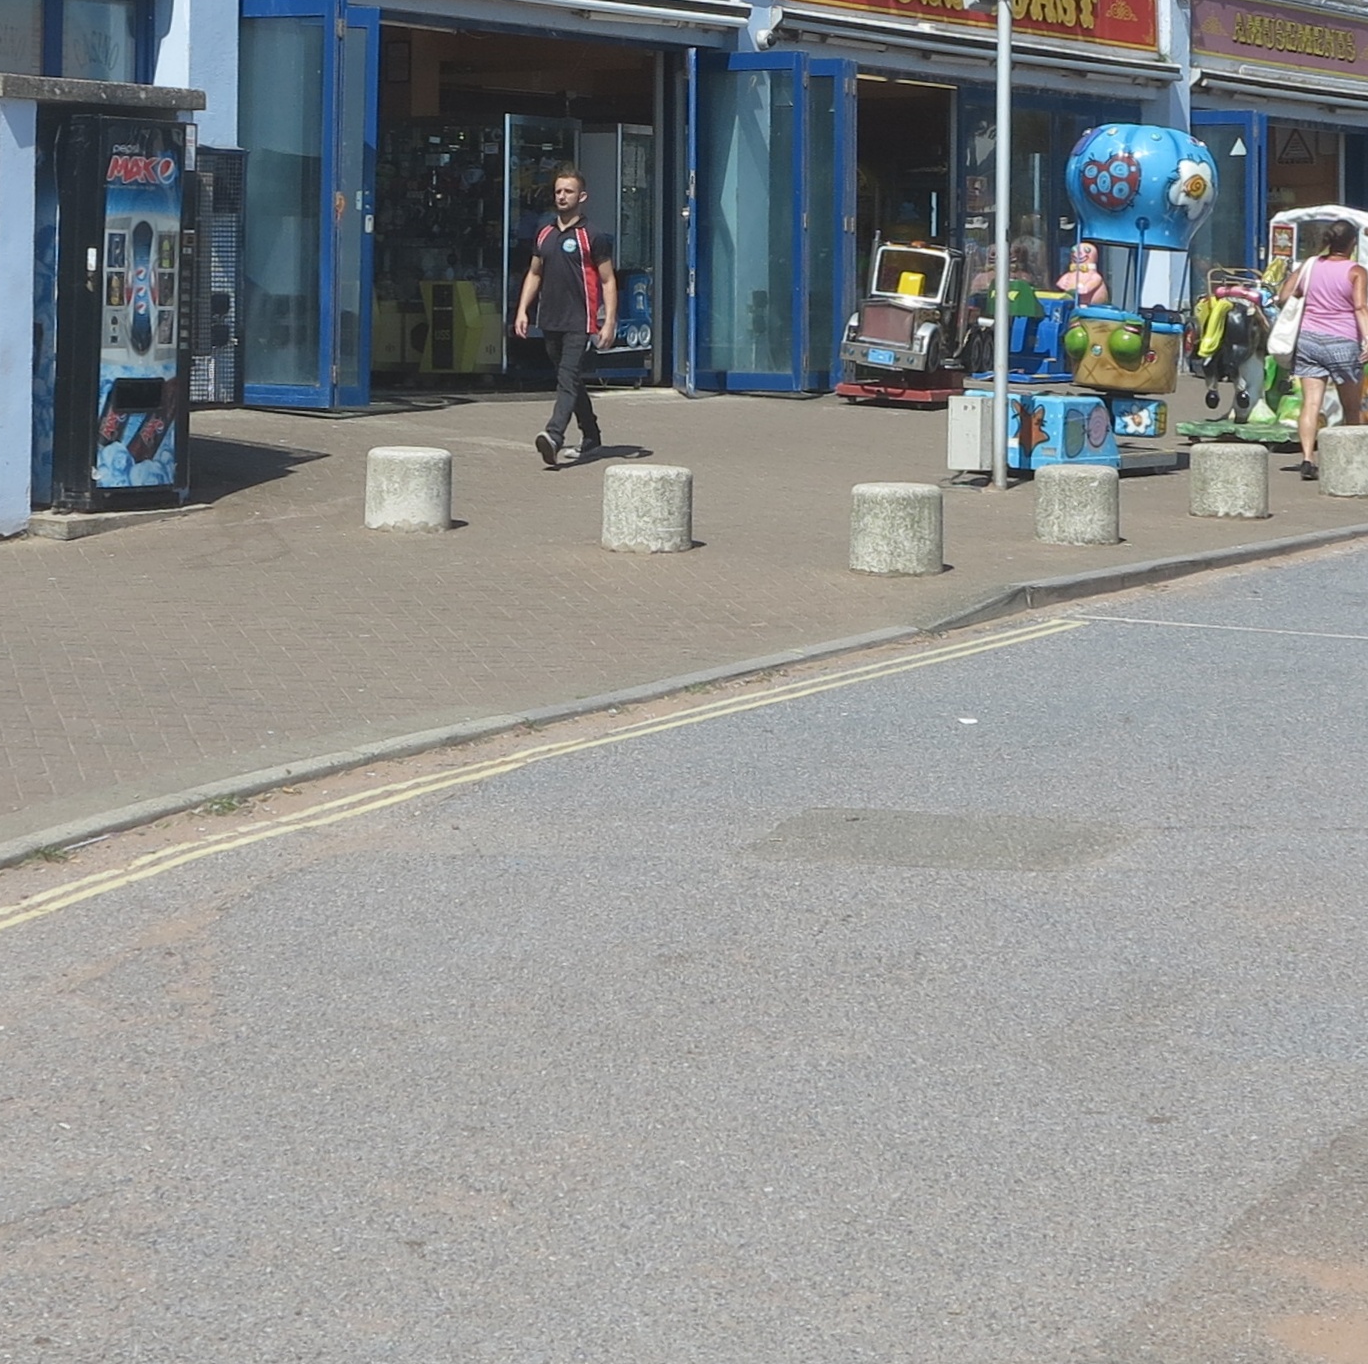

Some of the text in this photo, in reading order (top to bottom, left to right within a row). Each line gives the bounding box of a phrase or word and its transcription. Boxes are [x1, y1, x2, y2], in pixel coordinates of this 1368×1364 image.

[1232, 12, 1356, 63] AMUSEMENTS
[113, 144, 140, 154] pepsi
[106, 155, 160, 184] MAX
